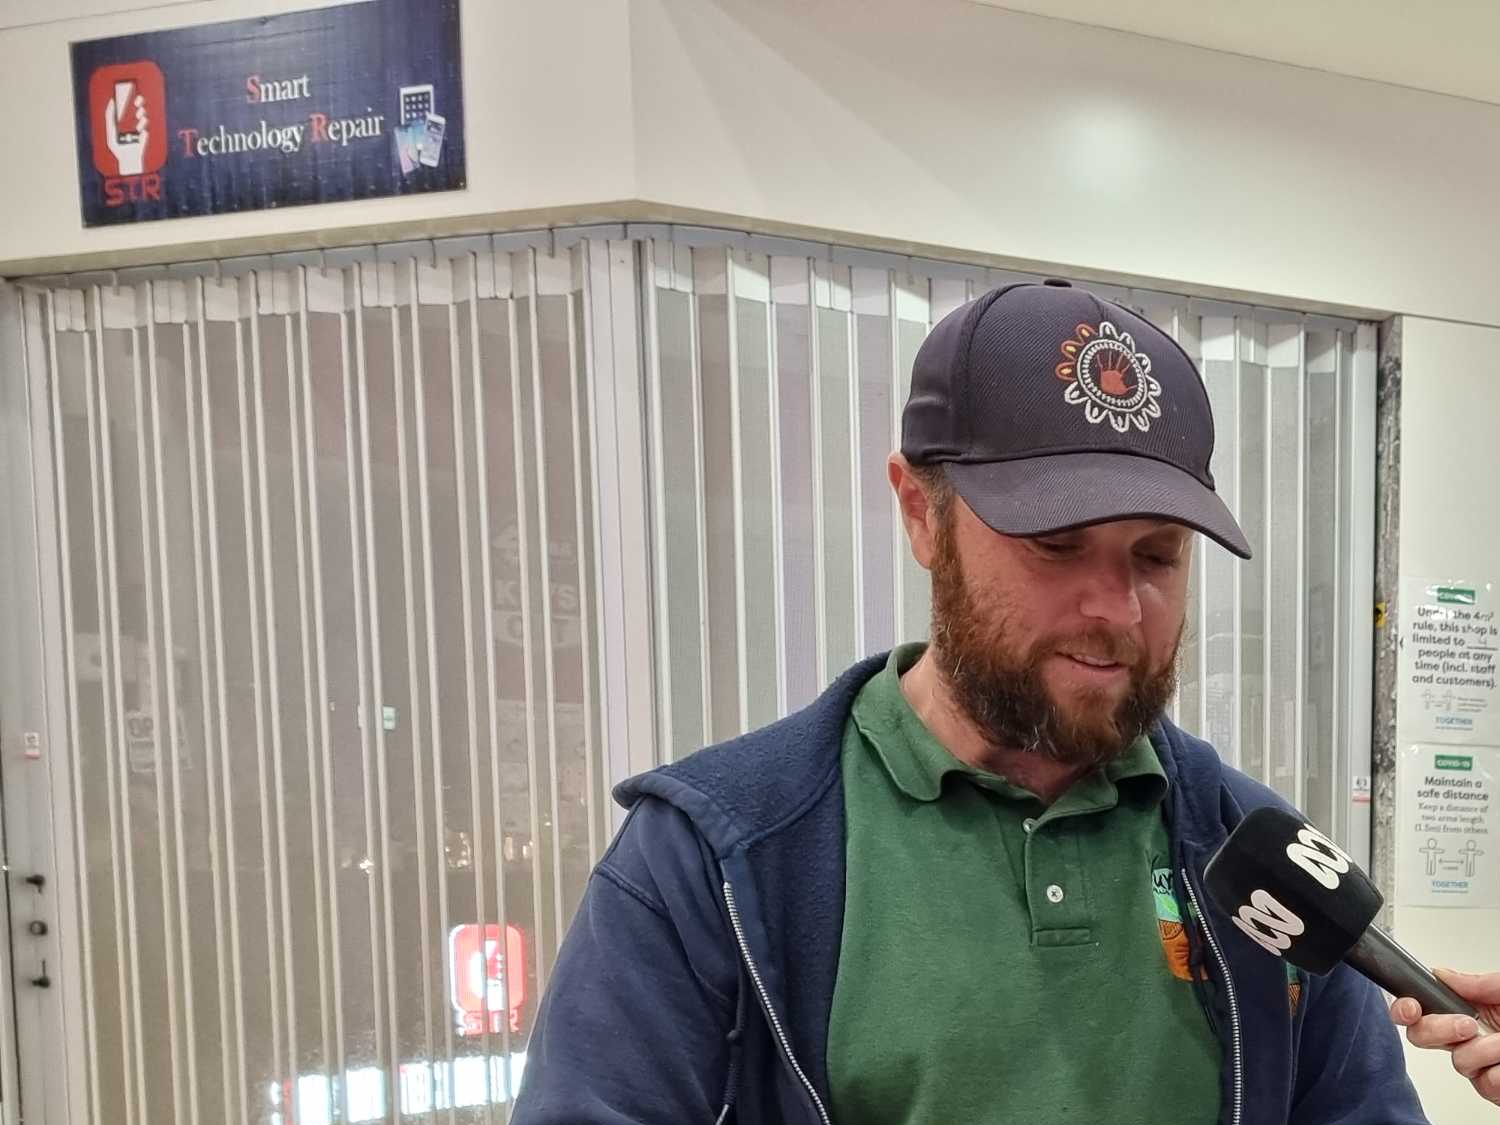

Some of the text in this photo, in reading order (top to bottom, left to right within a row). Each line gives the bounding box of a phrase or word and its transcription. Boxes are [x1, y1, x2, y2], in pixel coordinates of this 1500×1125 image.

[246, 74, 311, 103] Smart
[178, 107, 384, 158] Technology Repair
[105, 176, 162, 207] STR
[1412, 621, 1437, 633] rule,
[1440, 622, 1459, 633] this
[1489, 626, 1498, 636] is
[1412, 634, 1451, 646] limited
[1453, 636, 1465, 647] to
[1418, 648, 1493, 664] people at any
[1414, 660, 1496, 675] time (incl. staff
[1412, 673, 1497, 689] and customers).
[1424, 775, 1482, 789] Maintain a
[1417, 788, 1489, 801] safe distance
